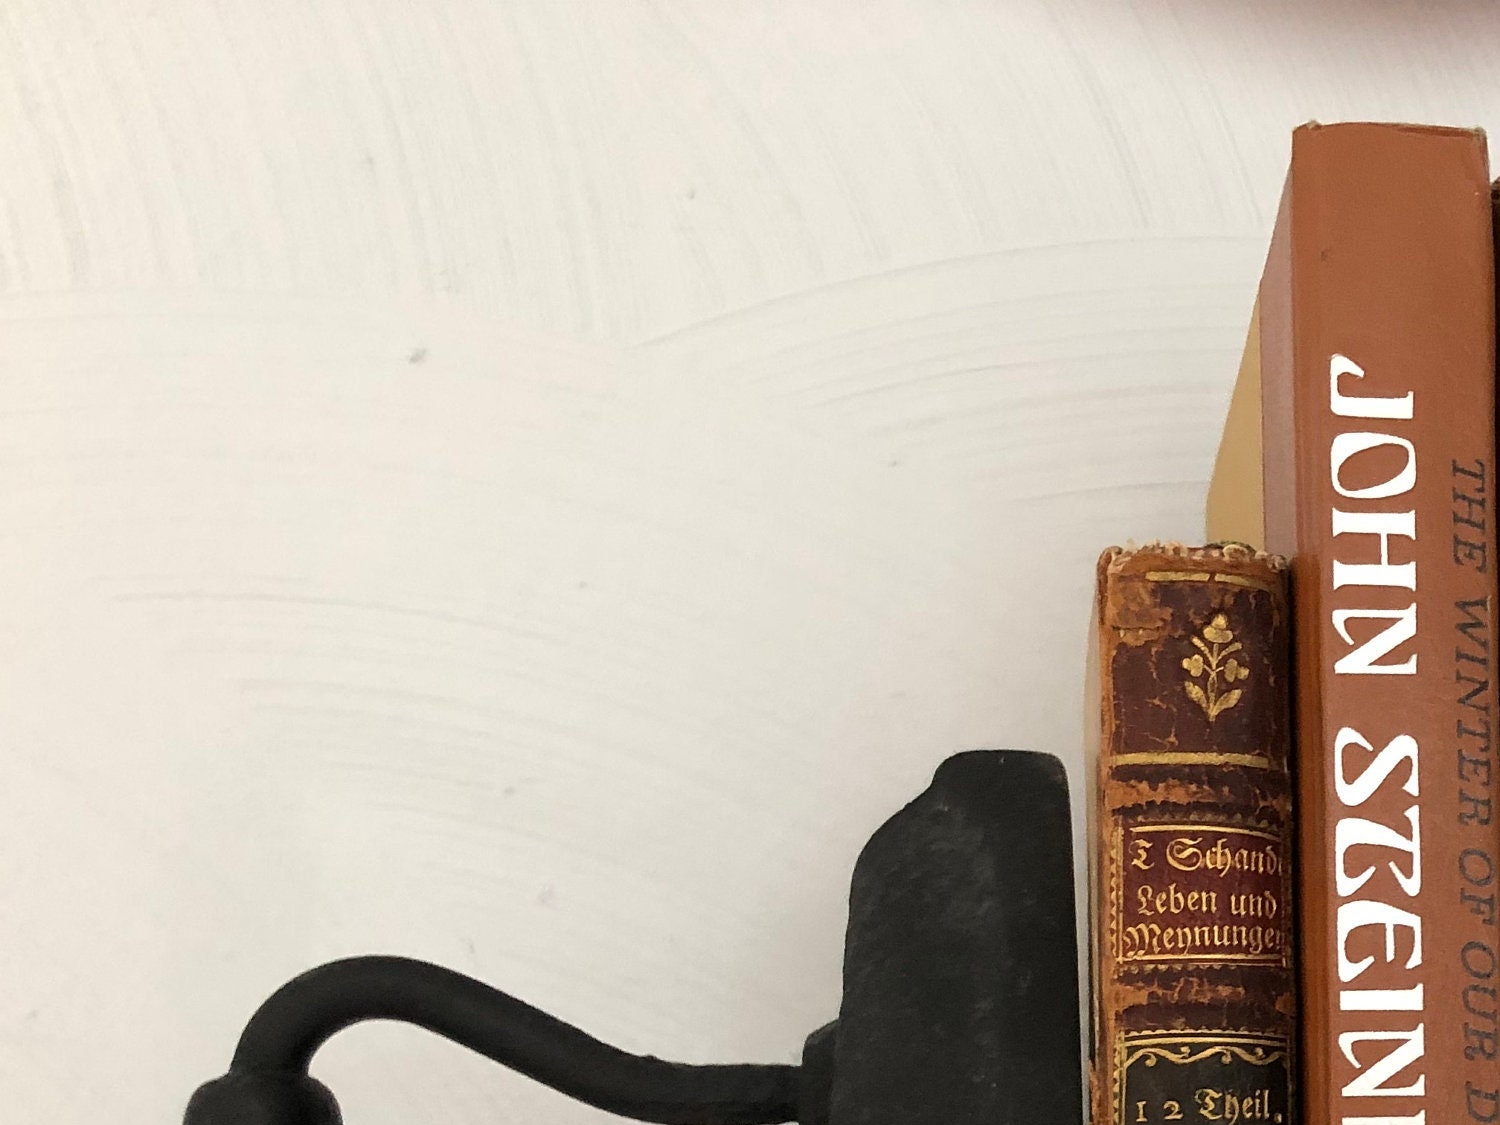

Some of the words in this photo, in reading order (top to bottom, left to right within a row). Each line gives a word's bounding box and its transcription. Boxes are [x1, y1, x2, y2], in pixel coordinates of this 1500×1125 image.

[1329, 353, 1418, 676] JOHN
[1452, 458, 1487, 574] THE
[1454, 594, 1493, 826] WINTER
[1230, 890, 1277, 919] und
[1458, 848, 1496, 926] OF
[1461, 940, 1500, 1062] OUR
